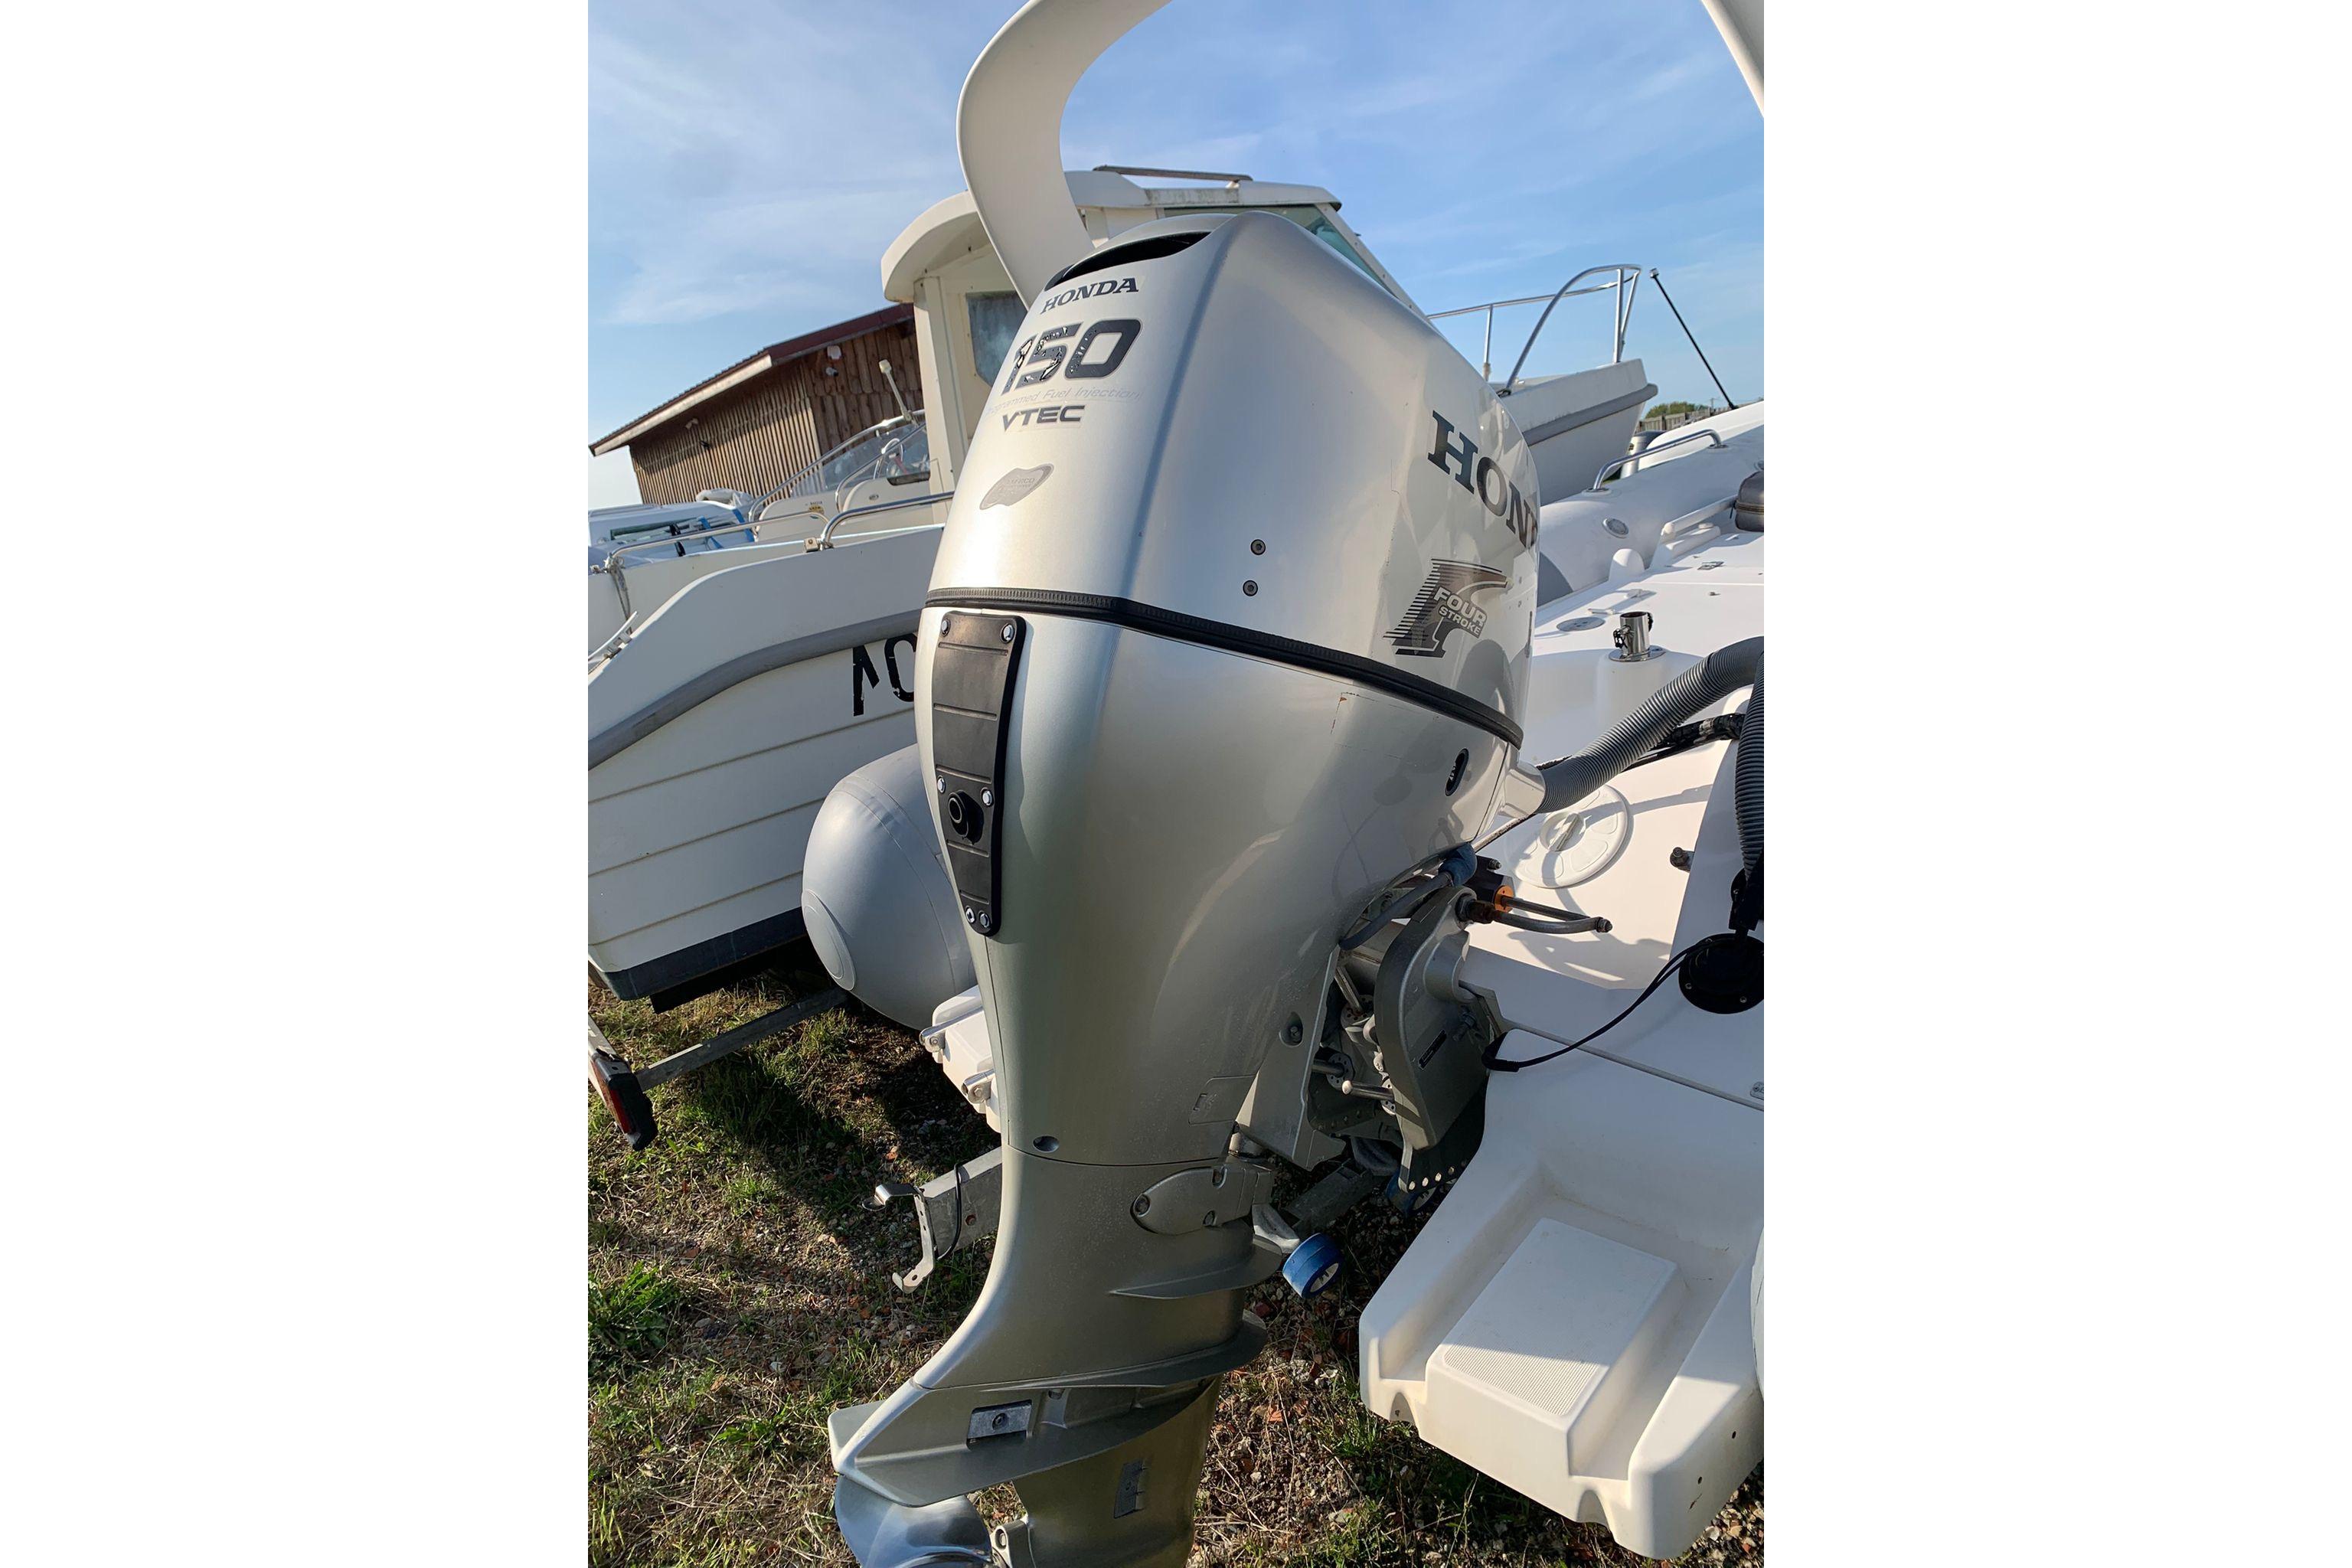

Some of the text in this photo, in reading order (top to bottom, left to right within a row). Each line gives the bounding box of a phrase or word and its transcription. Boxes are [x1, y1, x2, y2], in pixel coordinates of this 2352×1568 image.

[1040, 277, 1139, 315] HONDA
[1001, 318, 1142, 396] 150
[1044, 387, 1073, 399] Fuel
[1002, 404, 1086, 432] VTEC
[1433, 586, 1487, 627] FOUR
[1439, 605, 1482, 636] STROKE
